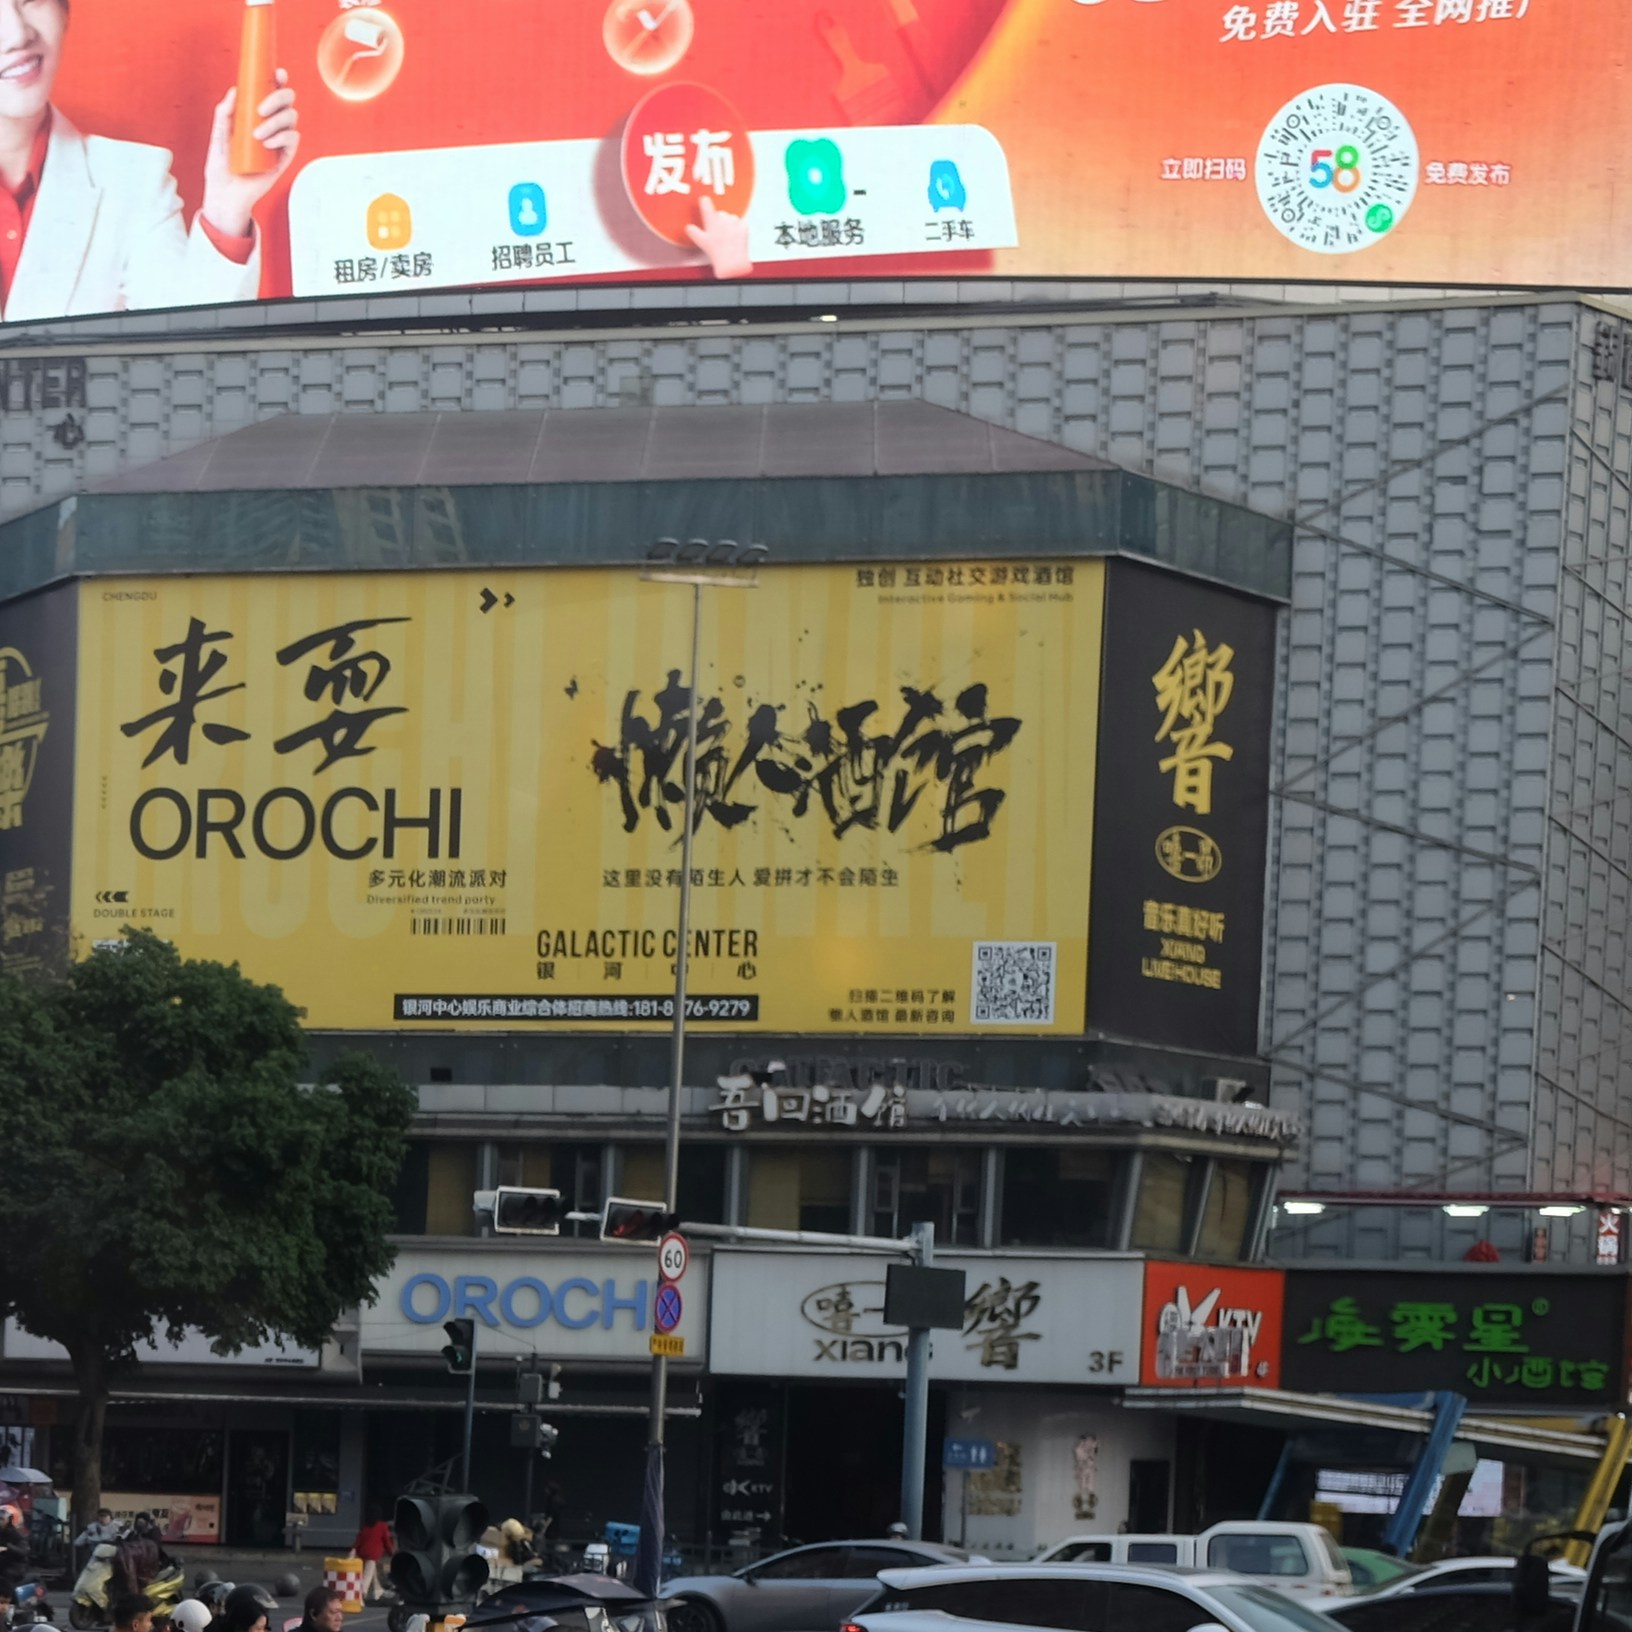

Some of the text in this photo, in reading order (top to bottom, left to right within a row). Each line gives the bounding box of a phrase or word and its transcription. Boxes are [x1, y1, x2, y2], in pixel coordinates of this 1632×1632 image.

[1219, 0, 1381, 43] 免费入驻
[642, 130, 735, 196] 发布
[1160, 157, 1247, 182] 立即扫码
[1309, 146, 1361, 193] 58
[1425, 162, 1512, 187] 免费发布
[774, 217, 865, 248] 本地服务
[924, 219, 975, 242] 二手车
[334, 252, 433, 284] 租房/卖房
[491, 241, 576, 271] 招聘员工
[129, 786, 463, 861] OROCHI
[368, 870, 507, 888] 多元化潮流派对
[602, 868, 747, 888] 这里没有陌生人
[366, 894, 429, 905] Diversified
[431, 894, 463, 905] trend
[93, 908, 175, 918] DOUBLE STAGE
[536, 930, 656, 958] GALACTIC
[402, 998, 751, 1017] 银河中心娱乐商业综合体招商热线:181-876-9279
[664, 1250, 683, 1269] 60
[400, 1273, 658, 1331] OROCH
[1088, 1351, 1124, 1374] 3F
[1466, 1356, 1610, 1390] 小酒馆
